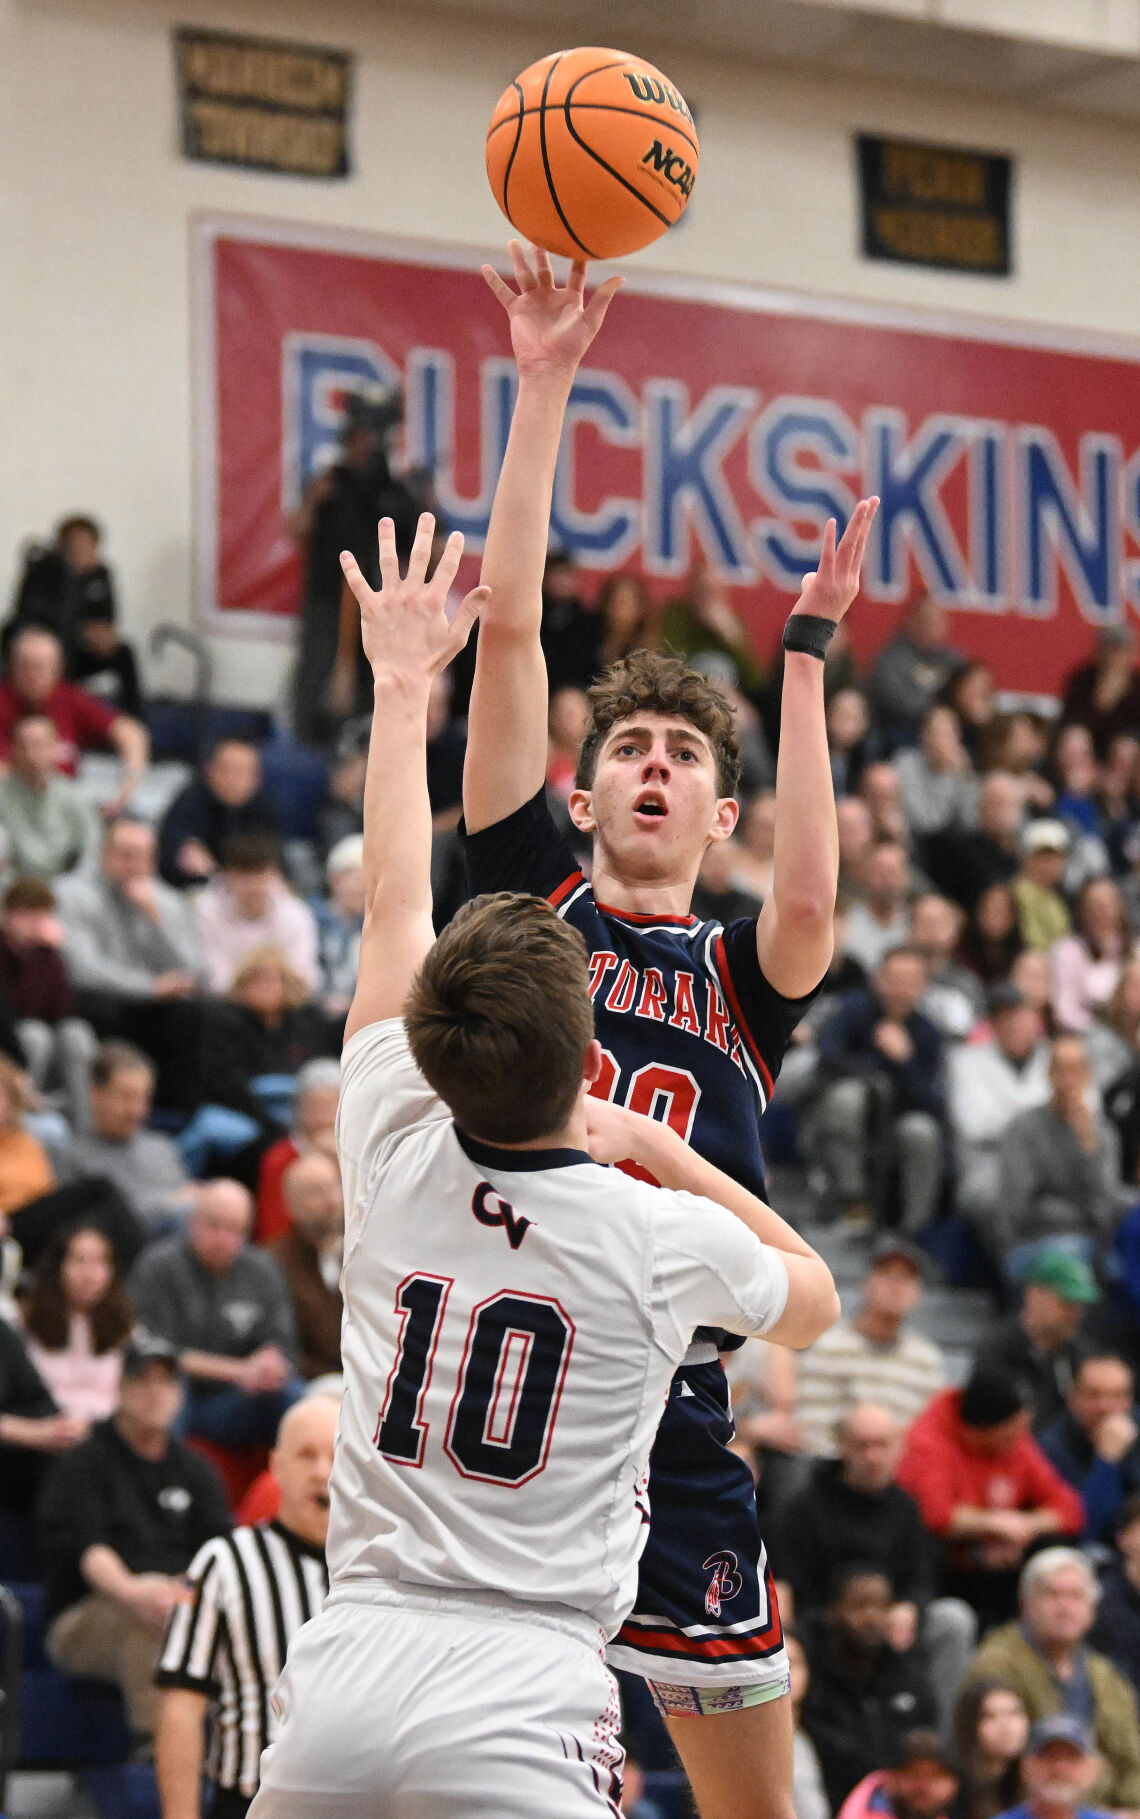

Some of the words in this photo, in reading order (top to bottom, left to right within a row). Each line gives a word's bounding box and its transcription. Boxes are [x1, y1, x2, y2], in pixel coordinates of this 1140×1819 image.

[282, 332, 1140, 626] UCKSKIN
[585, 1048, 702, 1190] 0
[471, 1181, 538, 1250] CV
[373, 1271, 576, 1488] 10
